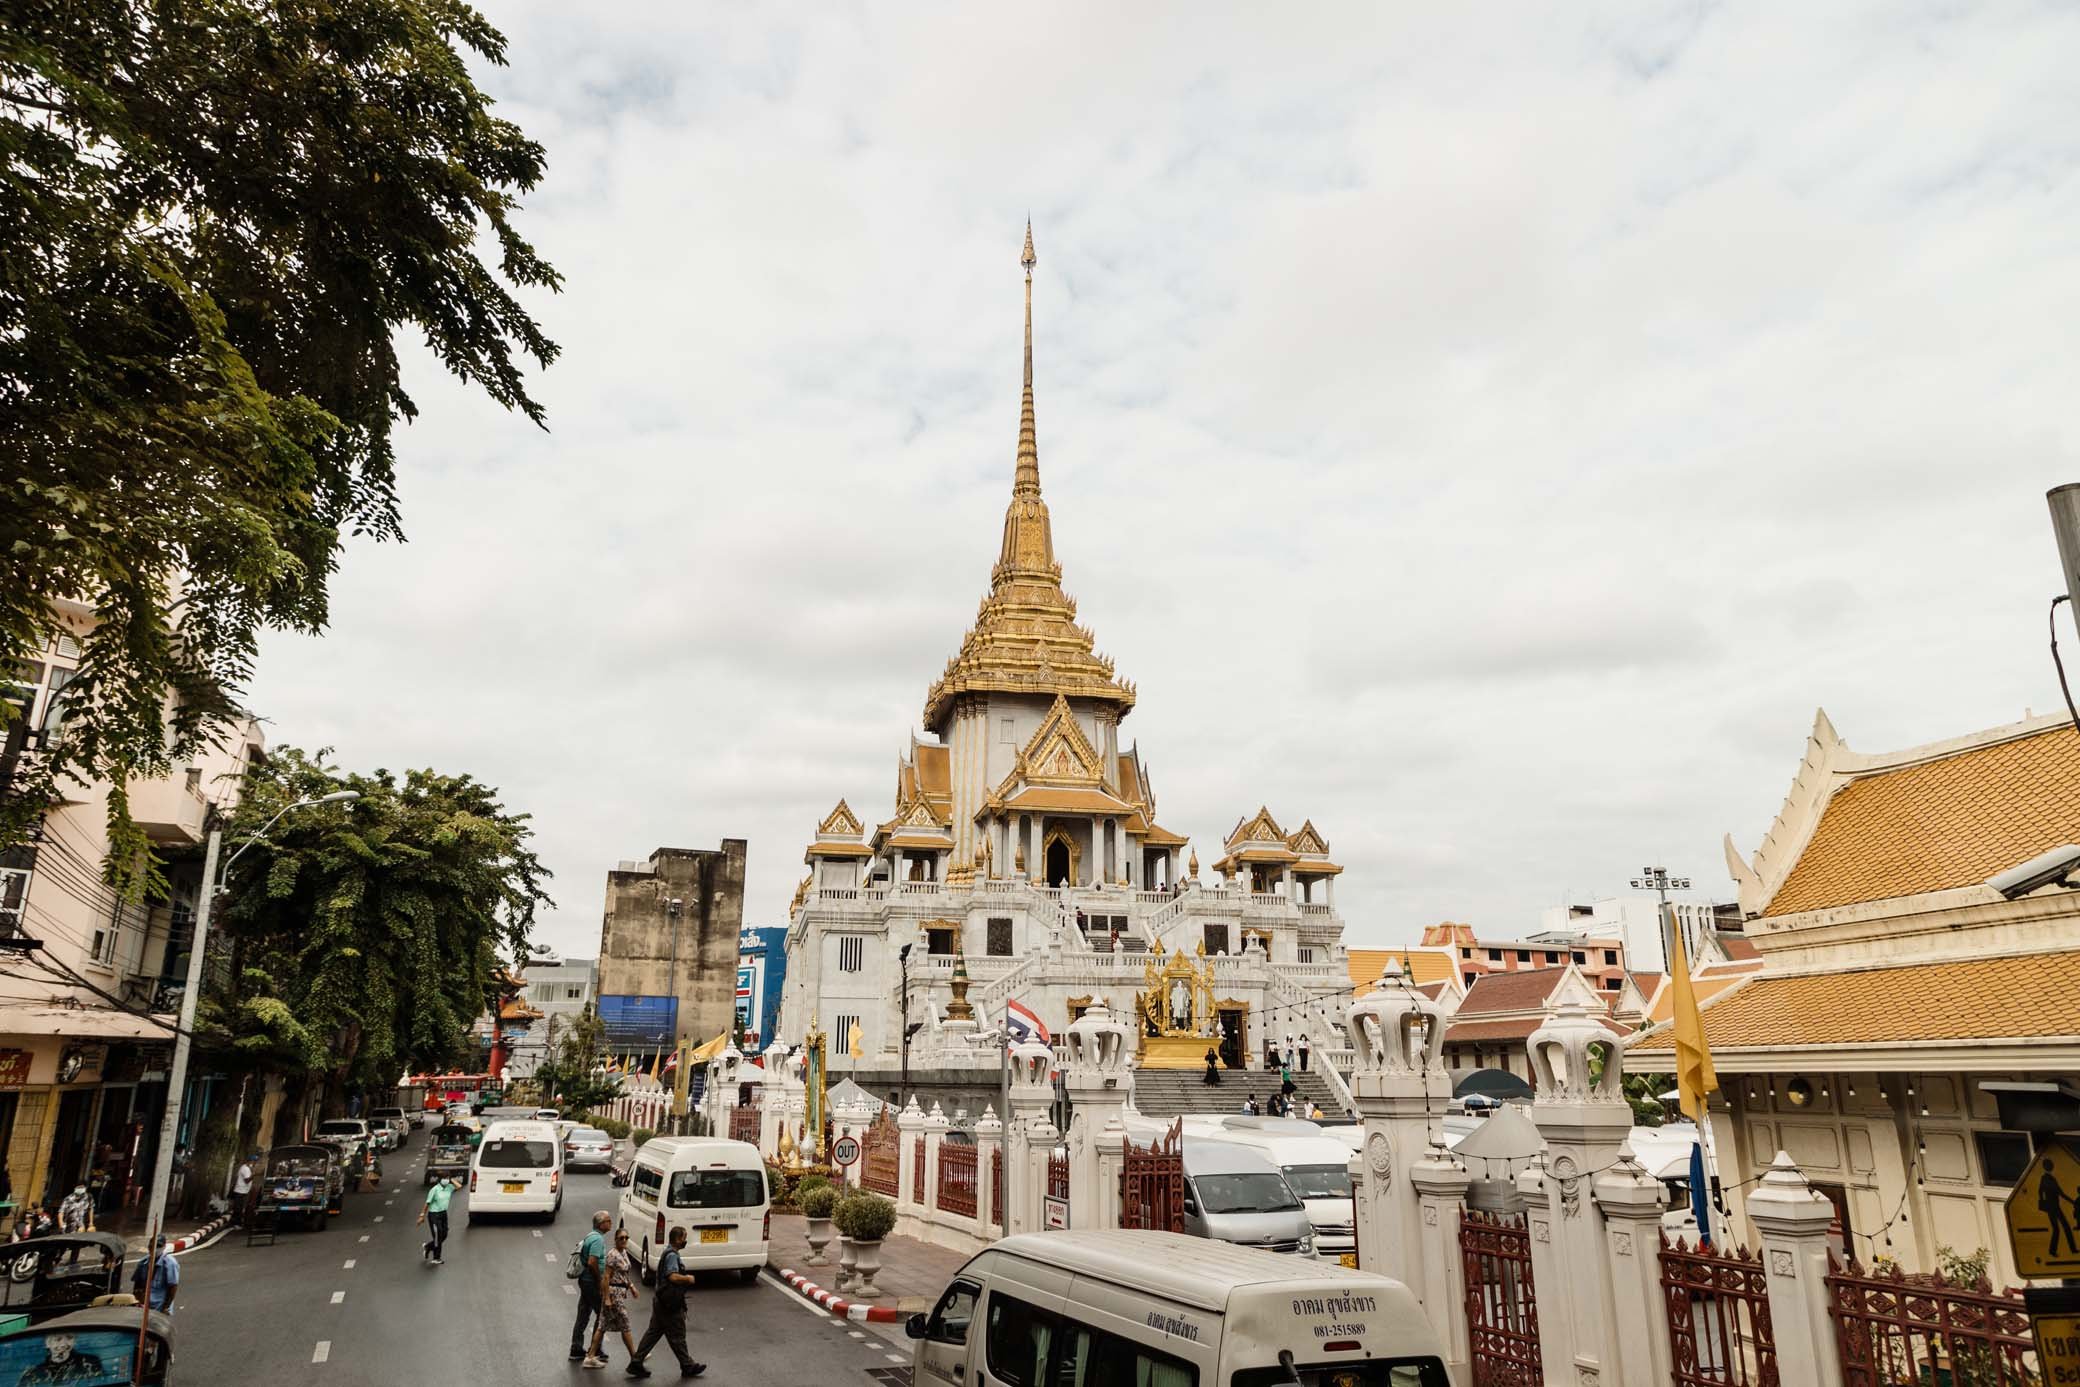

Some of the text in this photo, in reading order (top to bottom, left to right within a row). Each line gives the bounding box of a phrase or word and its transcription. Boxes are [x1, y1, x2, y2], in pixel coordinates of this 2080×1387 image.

[837, 1145, 855, 1158] OUT
[1293, 1299, 1324, 1315] อาคม
[1314, 1323, 1366, 1337] 081-2515889
